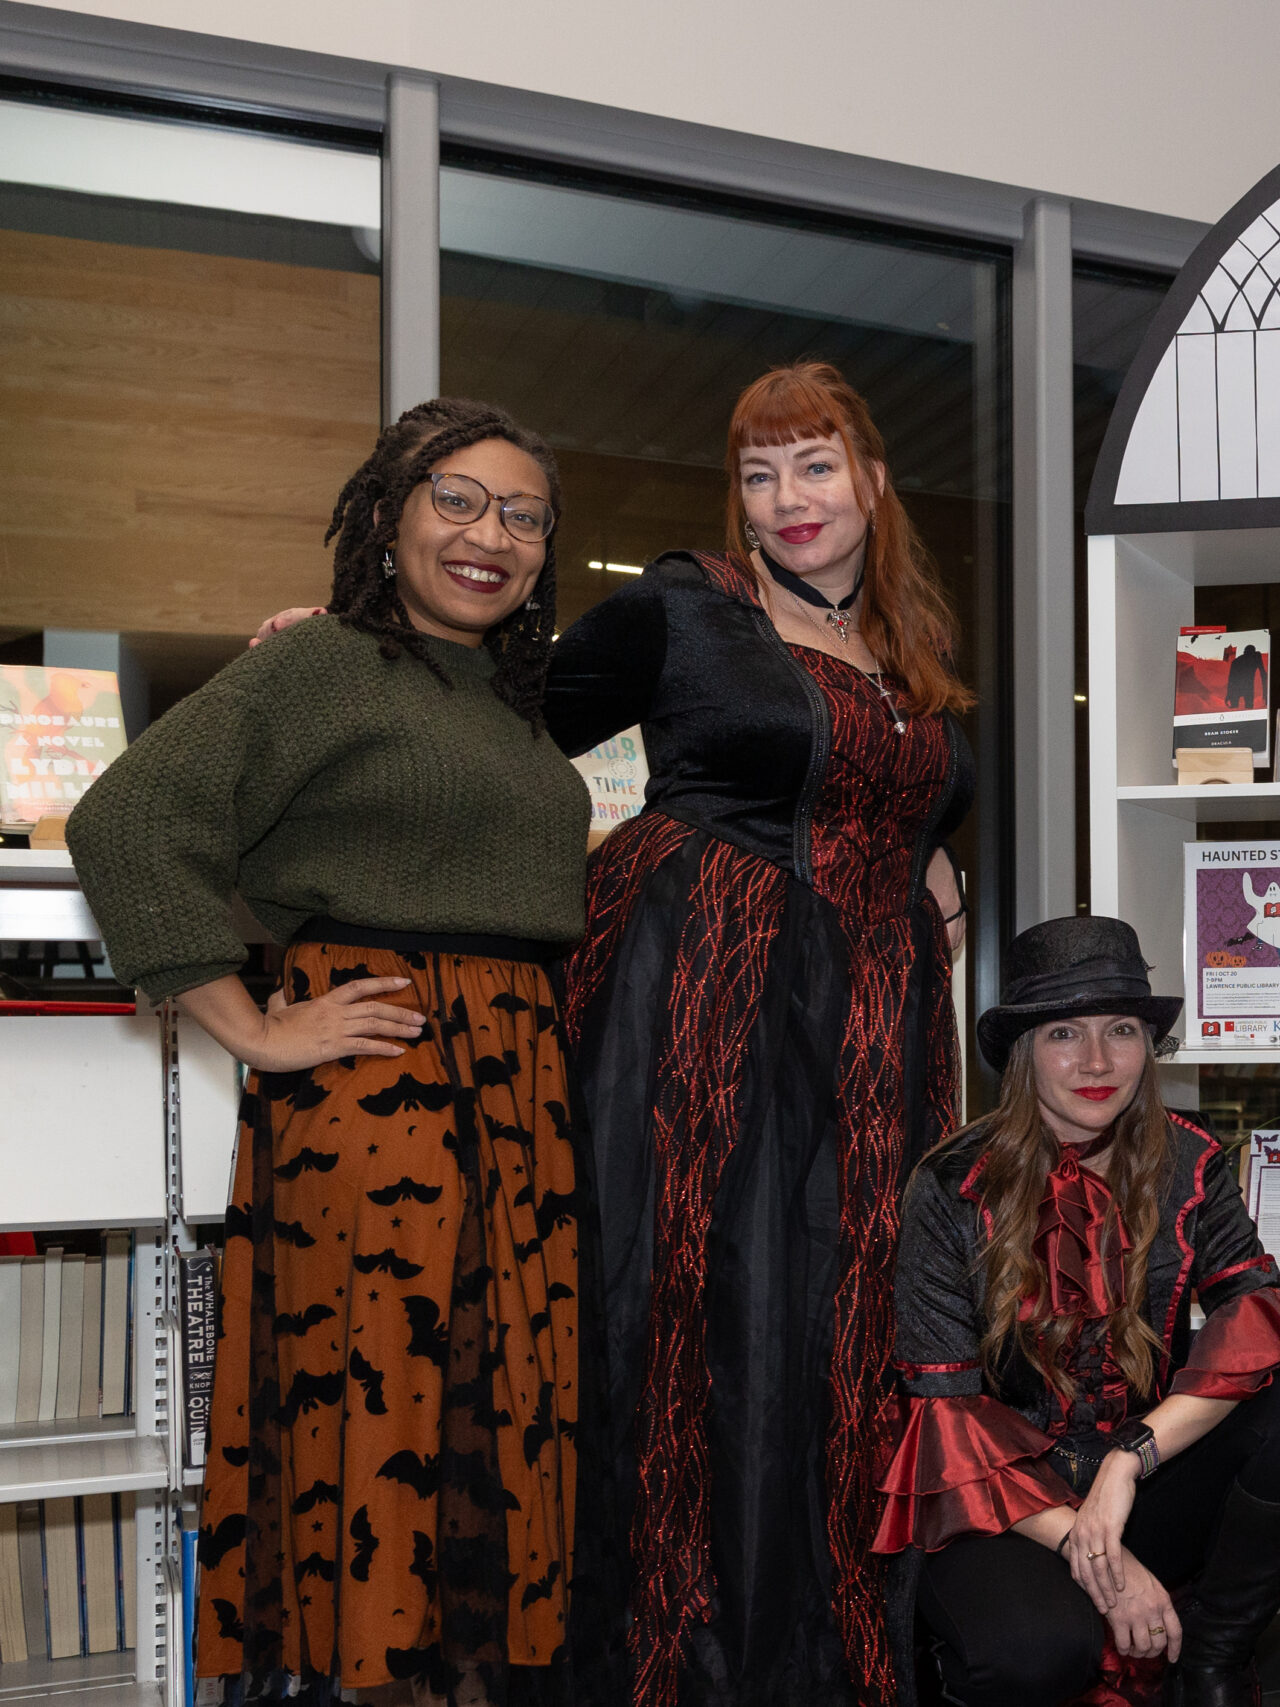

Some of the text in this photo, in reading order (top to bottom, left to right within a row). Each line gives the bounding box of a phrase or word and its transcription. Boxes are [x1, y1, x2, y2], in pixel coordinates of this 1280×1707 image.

[0, 713, 120, 729] DINOSAURS
[15, 735, 105, 748] A NOVEL
[11, 758, 109, 776] LYDIA
[593, 776, 638, 795] TIME
[1202, 850, 1267, 862] HAUNTED
[1235, 1024, 1268, 1032] LIBRARY
[187, 1275, 204, 1363] THEATRE
[204, 1275, 215, 1361] The WHALEBONE
[188, 1397, 205, 1435] QUIN
